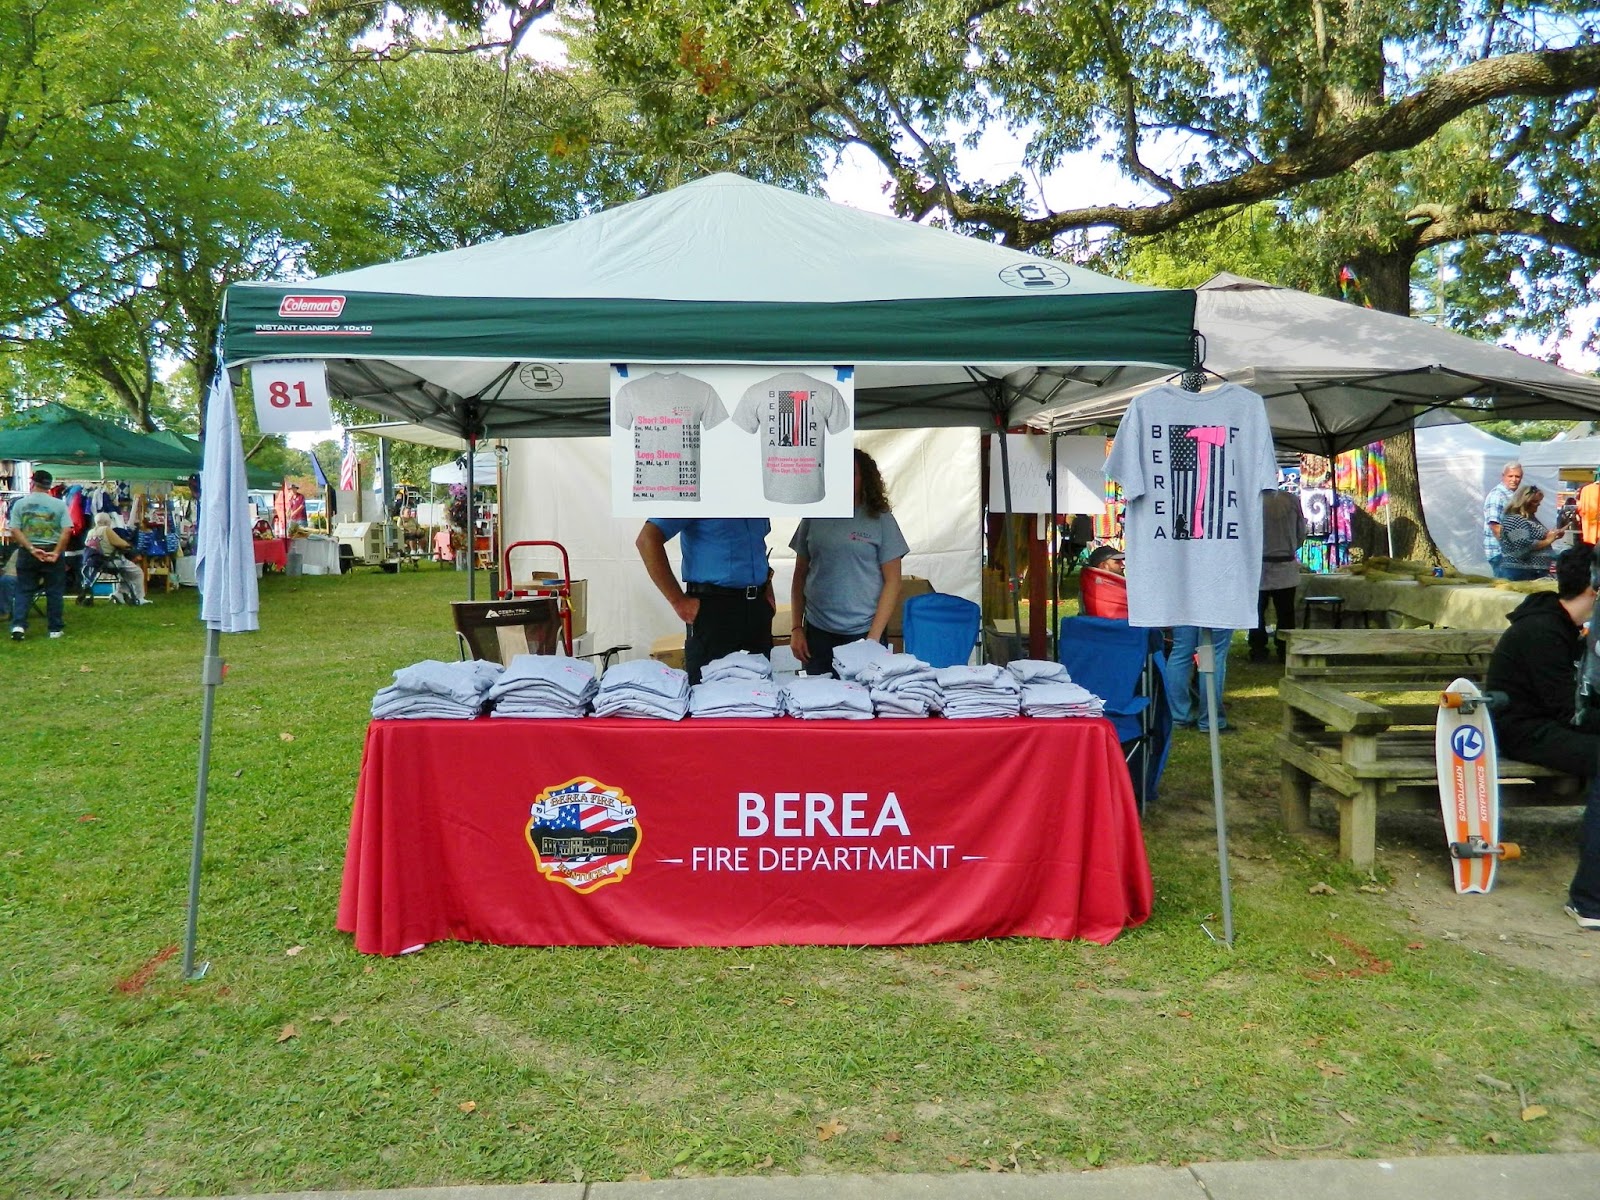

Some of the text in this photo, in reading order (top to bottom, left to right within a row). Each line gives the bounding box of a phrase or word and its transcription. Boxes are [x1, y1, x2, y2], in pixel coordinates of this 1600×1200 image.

[284, 298, 330, 311] Coleman
[269, 381, 313, 409] 81
[637, 416, 683, 424] Short Sleeve
[768, 391, 776, 446] BEREA
[809, 391, 817, 446] FIRE
[637, 450, 681, 461] Long Sleeve
[1151, 425, 1167, 540] BEREA
[1226, 426, 1240, 540] FIRE
[550, 793, 615, 808] BEREA FIRE
[1456, 765, 1467, 822] KRYPTONICS
[1477, 766, 1488, 822] KRYPTONICS
[536, 806, 542, 814] 19
[738, 792, 911, 837] BEREA
[557, 862, 611, 882] KENTUCKY
[692, 845, 955, 871] FIRE DEPARTMENT
